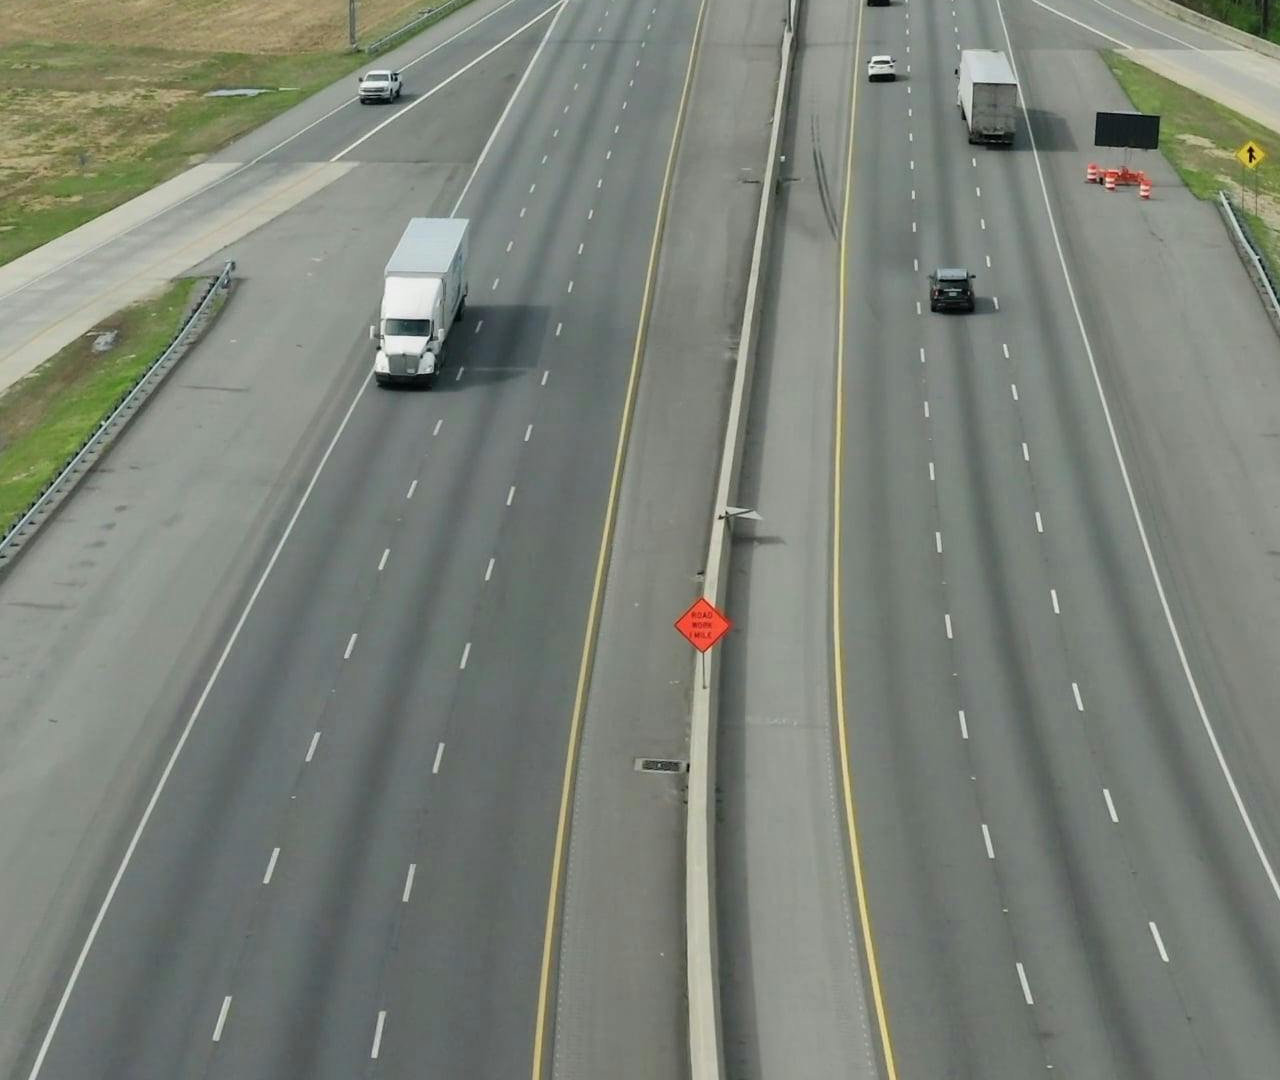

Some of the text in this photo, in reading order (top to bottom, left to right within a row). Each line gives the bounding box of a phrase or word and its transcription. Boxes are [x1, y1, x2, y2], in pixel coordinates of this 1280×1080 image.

[691, 611, 712, 619] ROAD
[692, 622, 712, 630] WORK
[694, 631, 712, 639] MILE
